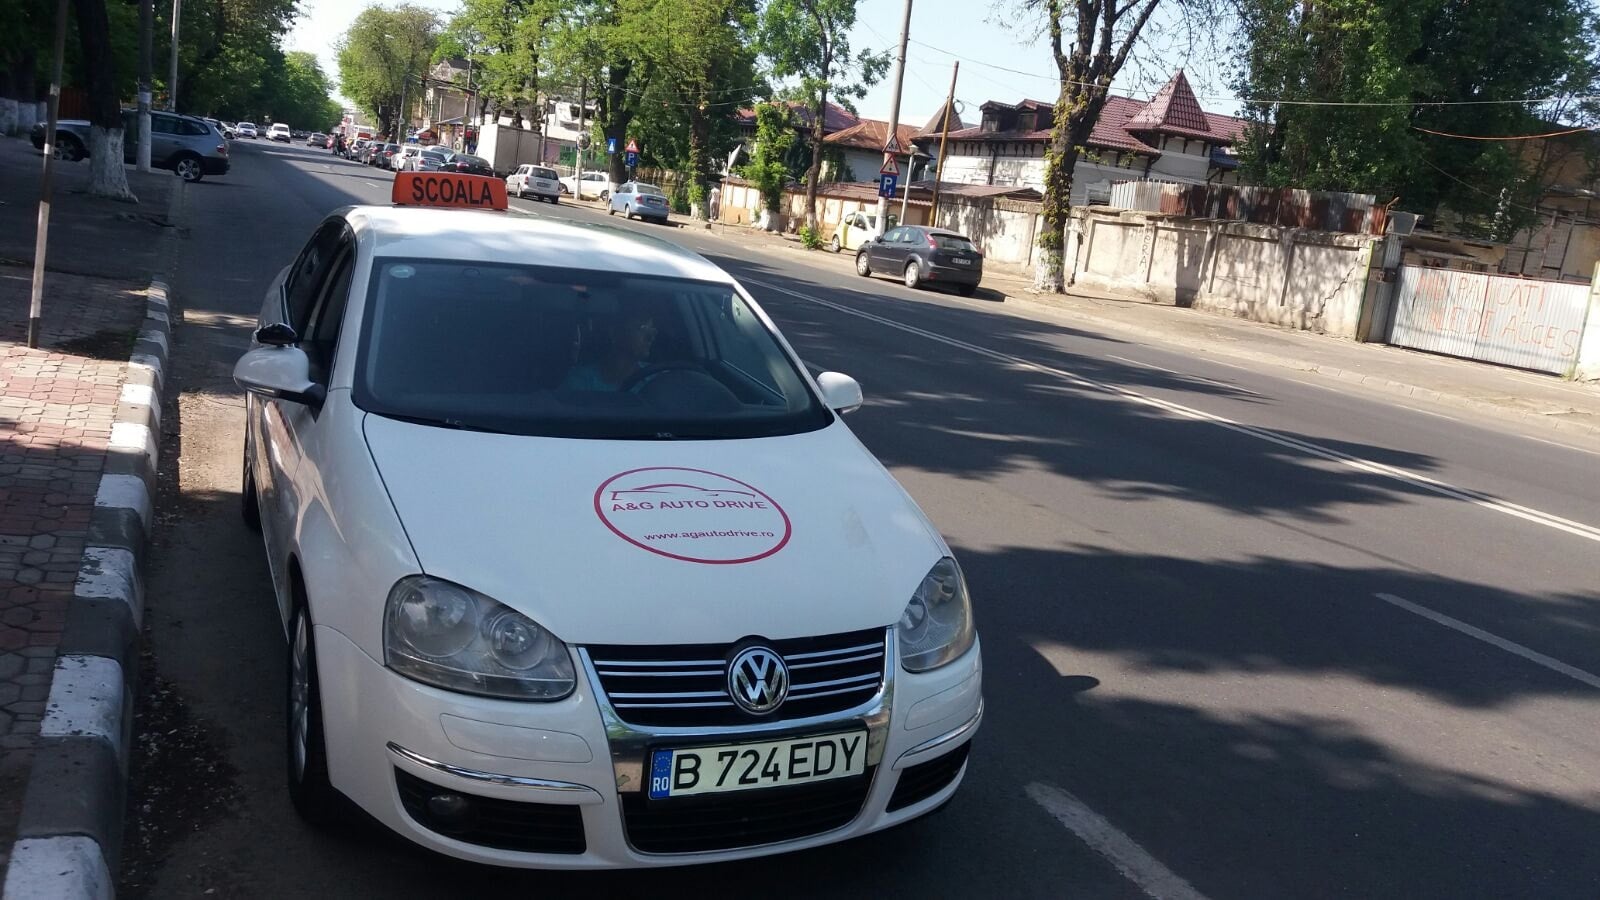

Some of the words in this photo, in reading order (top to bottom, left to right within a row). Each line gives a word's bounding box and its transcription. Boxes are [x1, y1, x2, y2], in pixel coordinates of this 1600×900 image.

[412, 176, 494, 206] SCOALA
[883, 177, 893, 190] P
[1501, 314, 1580, 357] ACCES
[612, 501, 655, 512] A&G
[660, 500, 709, 510] AUTO
[713, 500, 769, 510] DRIVE
[643, 529, 775, 541] www.agautodrive.ro
[673, 753, 702, 790] B
[715, 747, 780, 787] 724
[787, 736, 861, 780] EDY
[652, 776, 669, 793] RO
